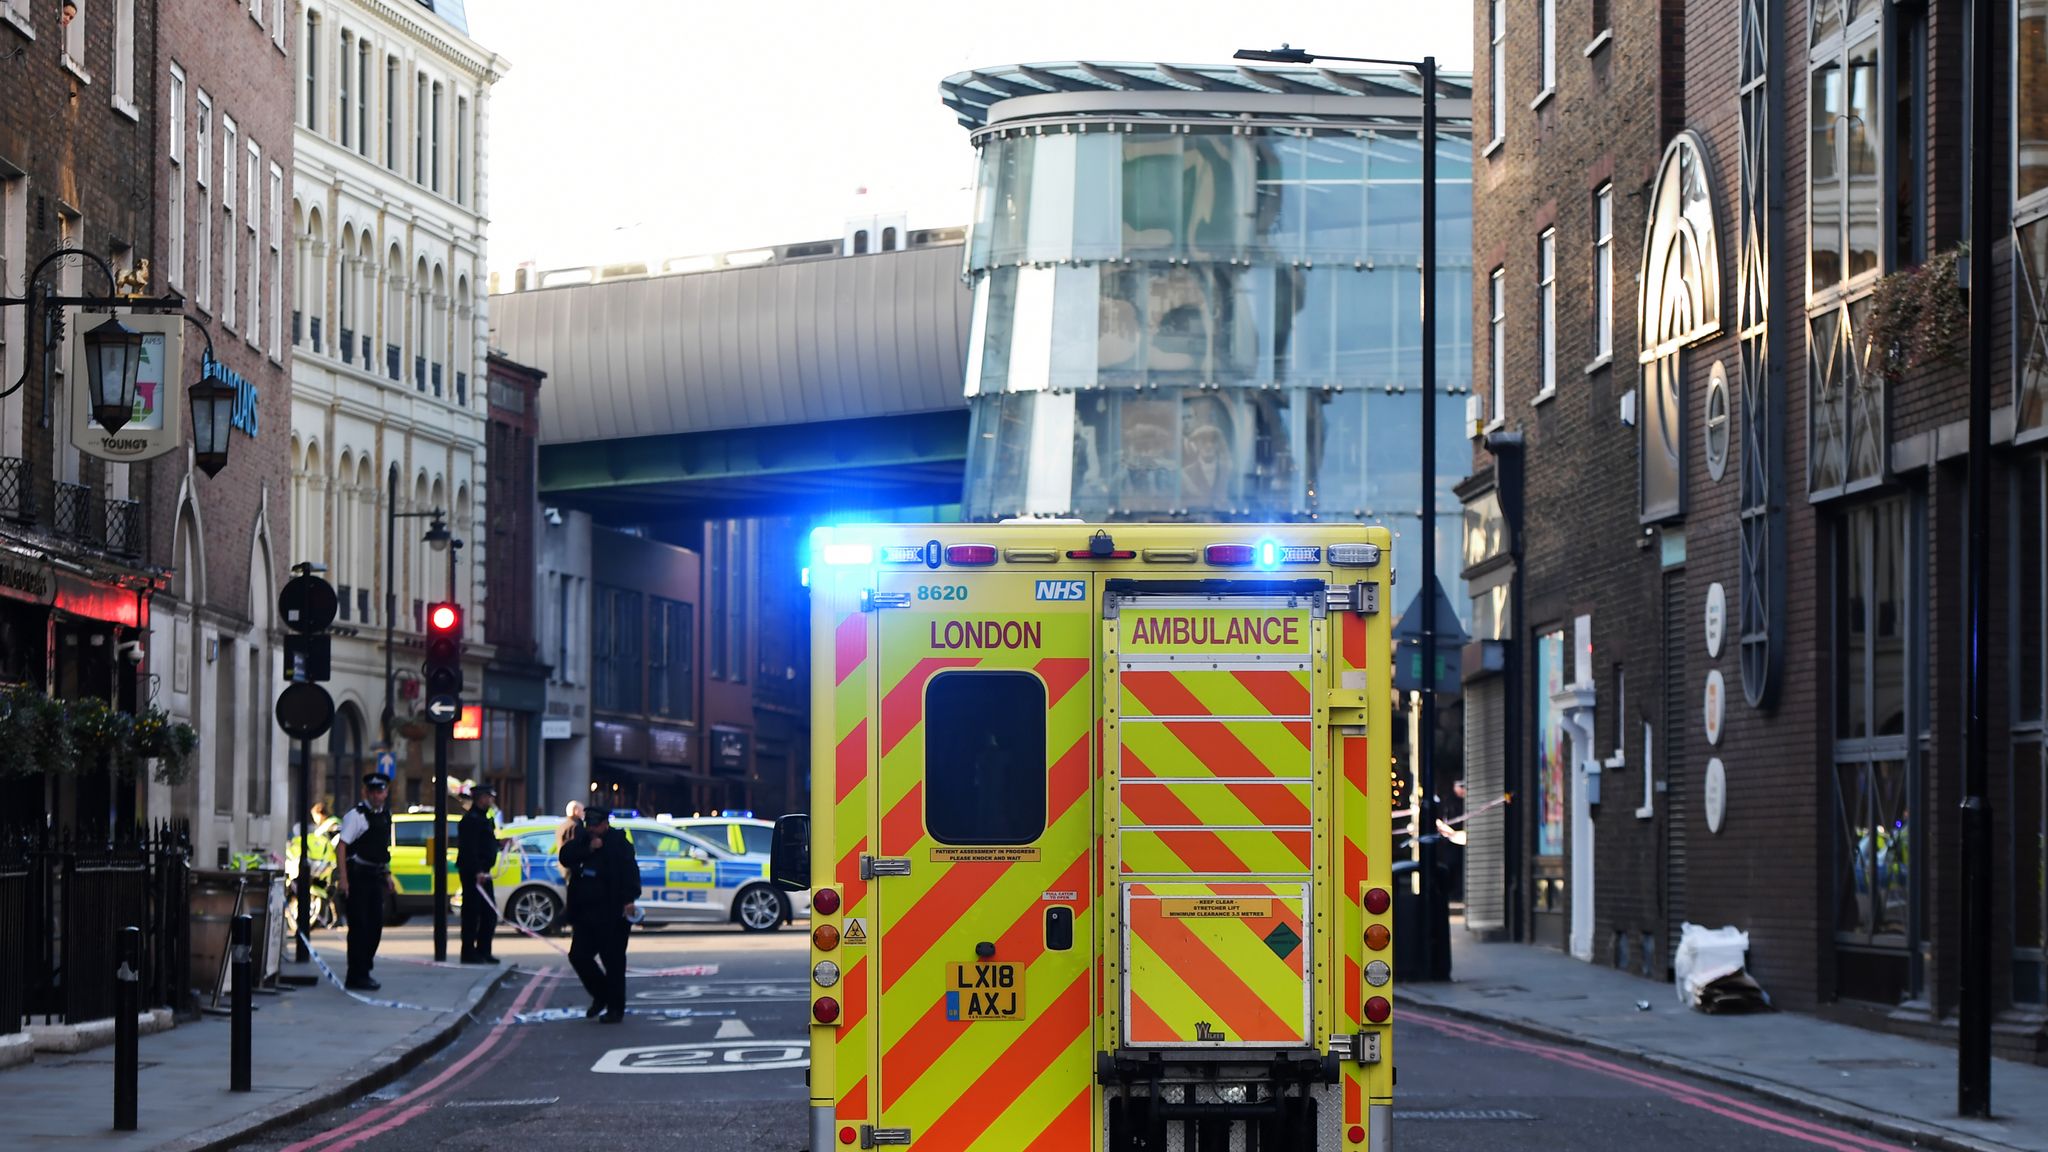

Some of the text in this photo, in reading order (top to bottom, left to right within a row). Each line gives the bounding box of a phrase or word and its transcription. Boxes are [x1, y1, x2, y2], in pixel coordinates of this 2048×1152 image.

[101, 438, 148, 450] YOUNG'S
[917, 585, 968, 601] 8620
[1036, 581, 1085, 600] NHS
[931, 617, 1299, 649] LONDON AMBULANCE
[958, 965, 1014, 988] LX18
[968, 992, 1017, 1015] AXJ
[630, 1047, 804, 1067] 20
